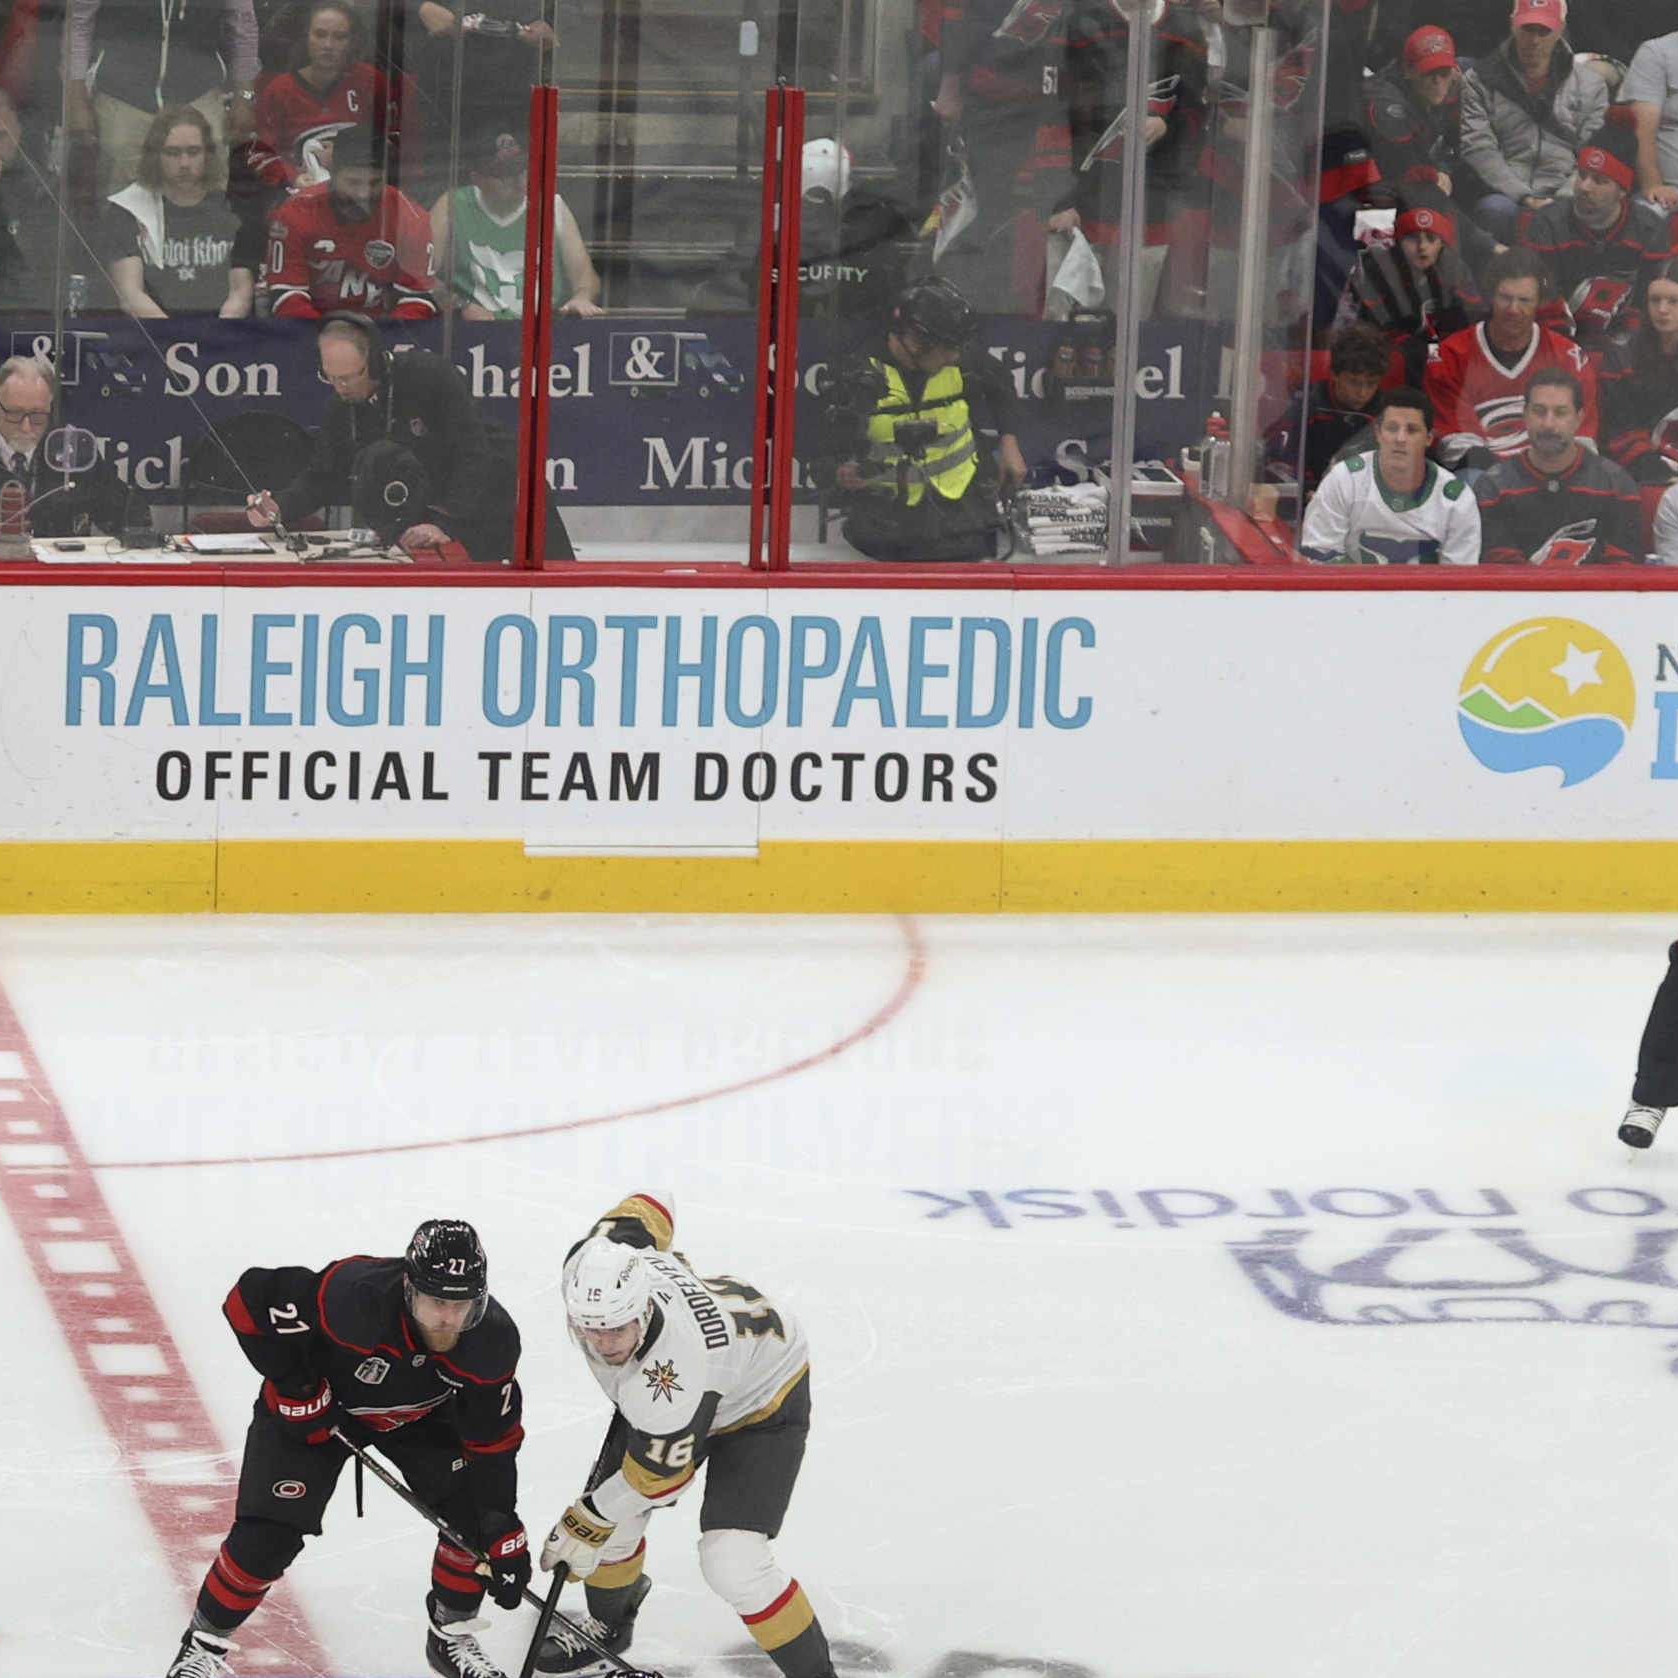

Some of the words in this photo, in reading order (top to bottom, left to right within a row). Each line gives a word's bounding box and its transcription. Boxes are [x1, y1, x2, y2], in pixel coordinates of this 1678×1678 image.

[347, 90, 360, 112] C
[772, 264, 869, 284] SCURITY
[163, 341, 282, 397] Son
[625, 335, 665, 379] &
[65, 613, 446, 727] RALEIGH
[482, 614, 1096, 730] ORTHOPAEDIC
[156, 750, 449, 801] OFFICIAL
[478, 751, 660, 801] TEAM
[694, 752, 997, 803] DOCTORS
[905, 1187, 1526, 1228] nordisk
[448, 1257, 466, 1276] 27
[587, 1287, 602, 1302] 16
[277, 1387, 332, 1418] BAUE
[643, 1433, 696, 1469] 16
